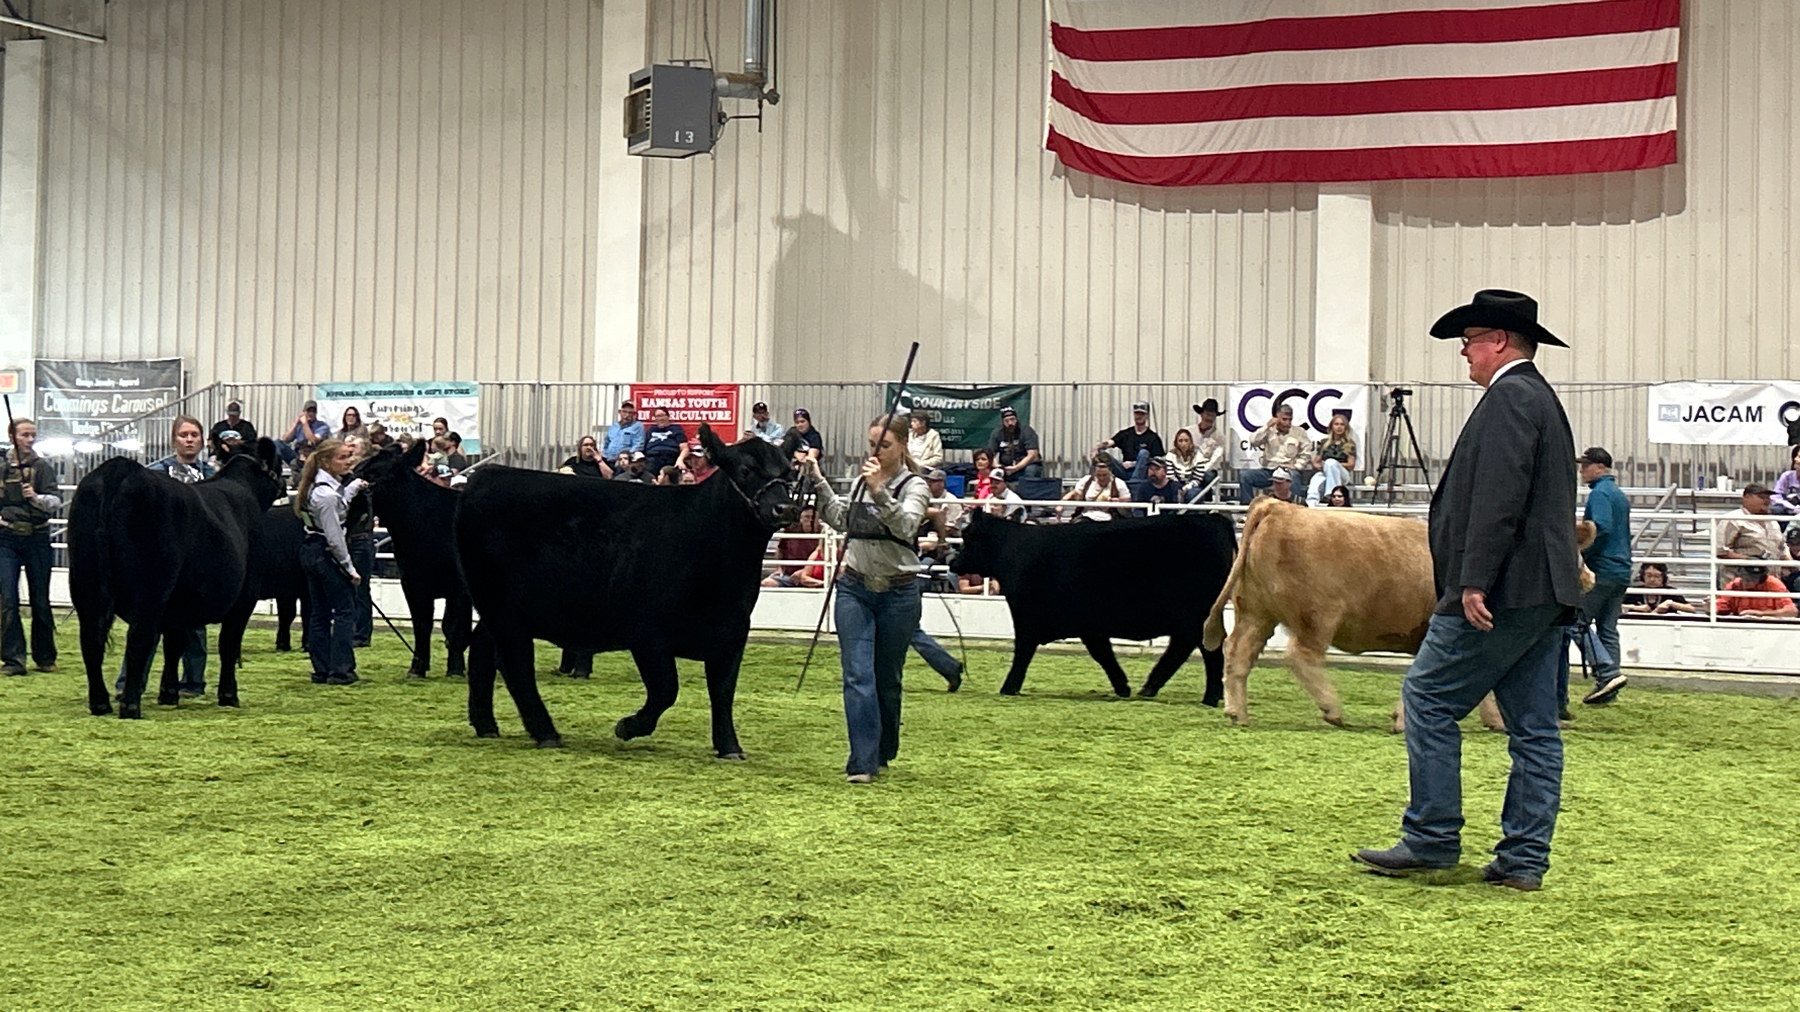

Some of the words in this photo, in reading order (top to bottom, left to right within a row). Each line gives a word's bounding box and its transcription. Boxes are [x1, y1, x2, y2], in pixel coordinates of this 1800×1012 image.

[674, 131, 694, 144] 13
[424, 388, 442, 396] GIFT
[44, 392, 109, 416] Cummings
[111, 392, 168, 414] Carousel
[641, 398, 686, 408] KANSAS
[687, 398, 728, 408] YOUTH
[912, 396, 1002, 410] COUNTRYSIDE
[637, 410, 650, 421] IN
[652, 410, 731, 421] RICULTURE
[1237, 388, 1353, 435] CCG
[1682, 405, 1763, 423] JACAM
[943, 416, 956, 424] LLC
